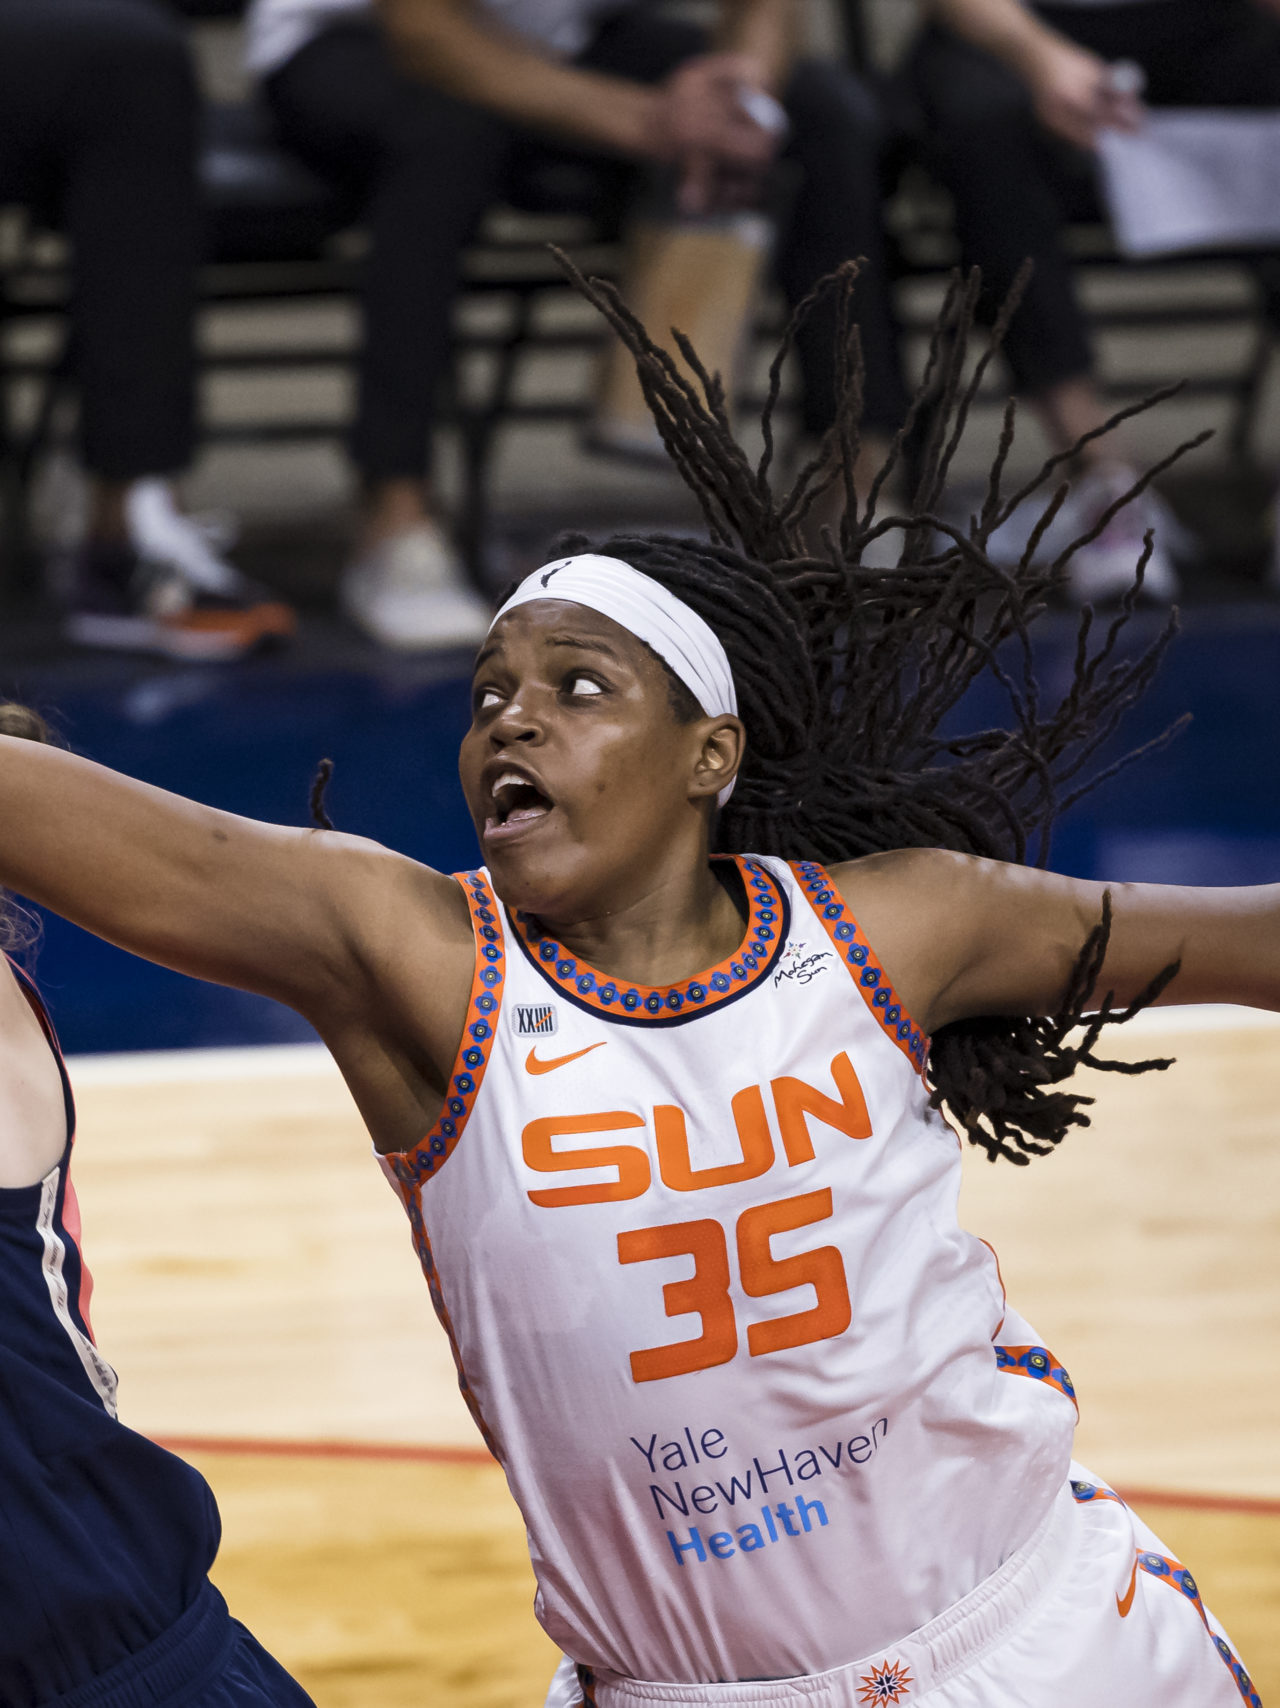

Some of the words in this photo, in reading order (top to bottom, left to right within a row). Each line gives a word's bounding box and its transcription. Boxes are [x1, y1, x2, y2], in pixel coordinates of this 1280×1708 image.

[774, 952, 833, 989] Mohegan
[797, 966, 827, 984] Sun
[521, 1051, 873, 1208] SUN
[616, 1186, 852, 1384] 35
[630, 1427, 728, 1473] Yale
[649, 1417, 888, 1520] NewHaven
[666, 1495, 829, 1566] Health
